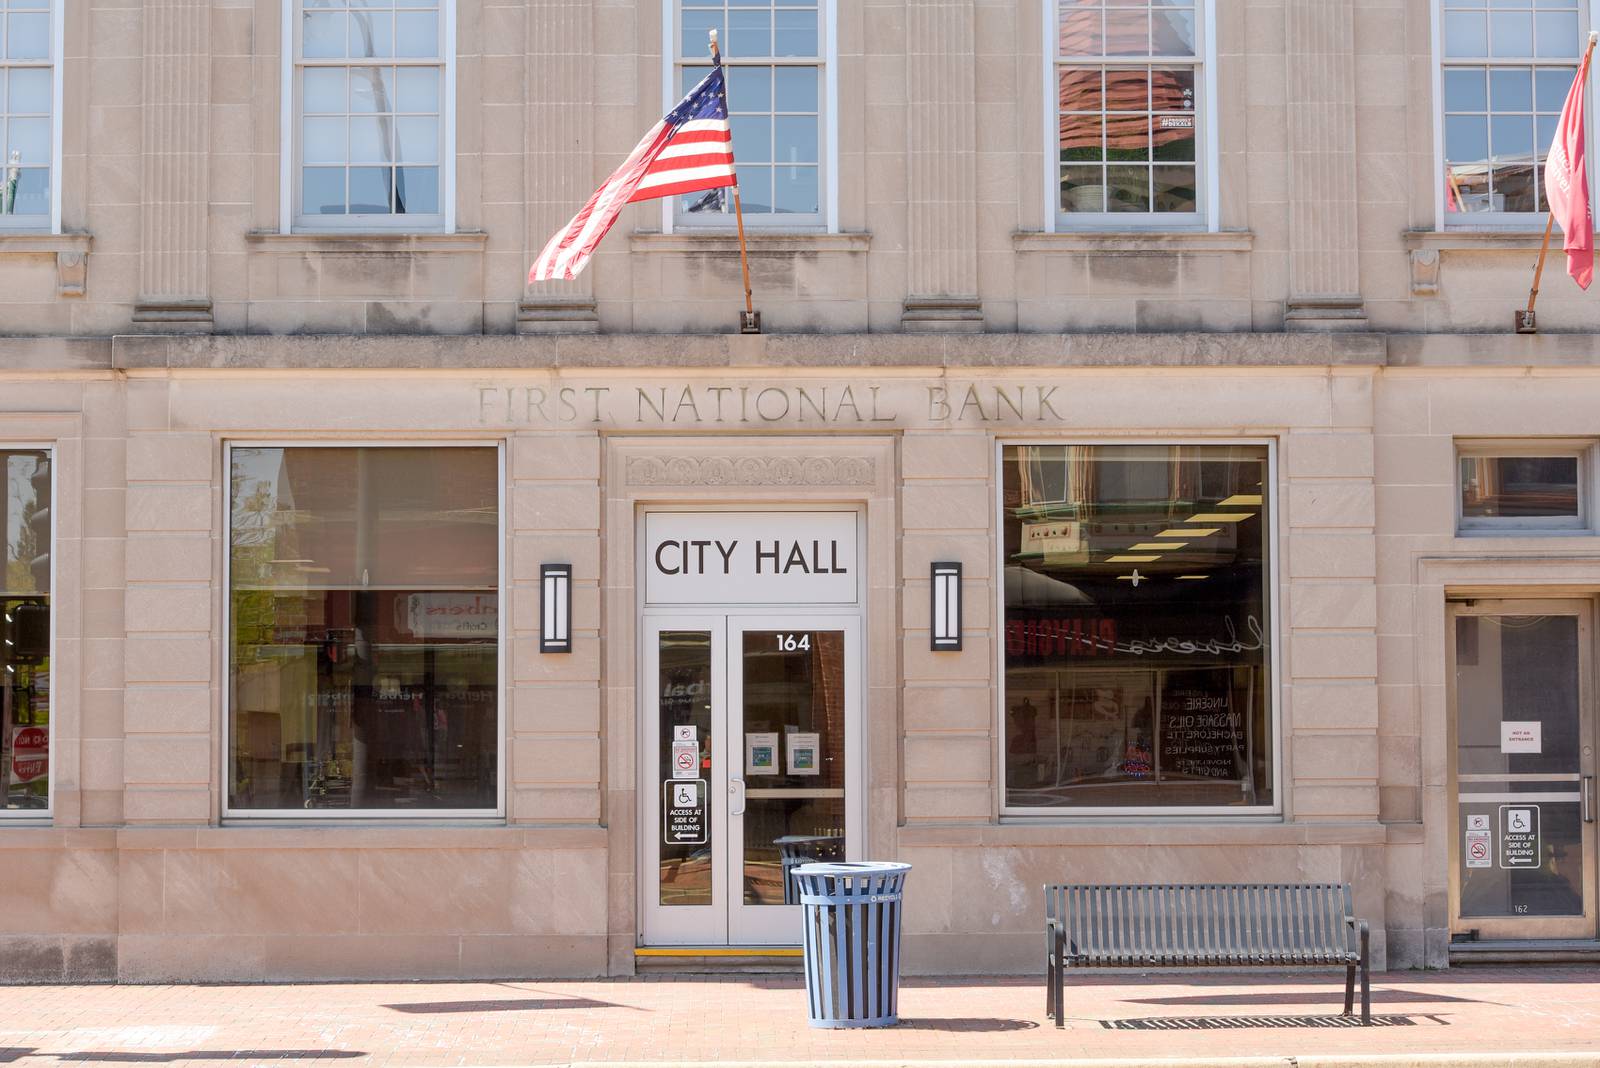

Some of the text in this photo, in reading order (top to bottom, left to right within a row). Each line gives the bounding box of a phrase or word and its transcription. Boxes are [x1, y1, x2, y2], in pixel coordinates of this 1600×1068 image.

[477, 385, 1066, 422] FIRST NATIONAL BANK
[655, 540, 847, 575] CITY HALL
[776, 634, 810, 651] 164
[1514, 904, 1528, 913] 162
